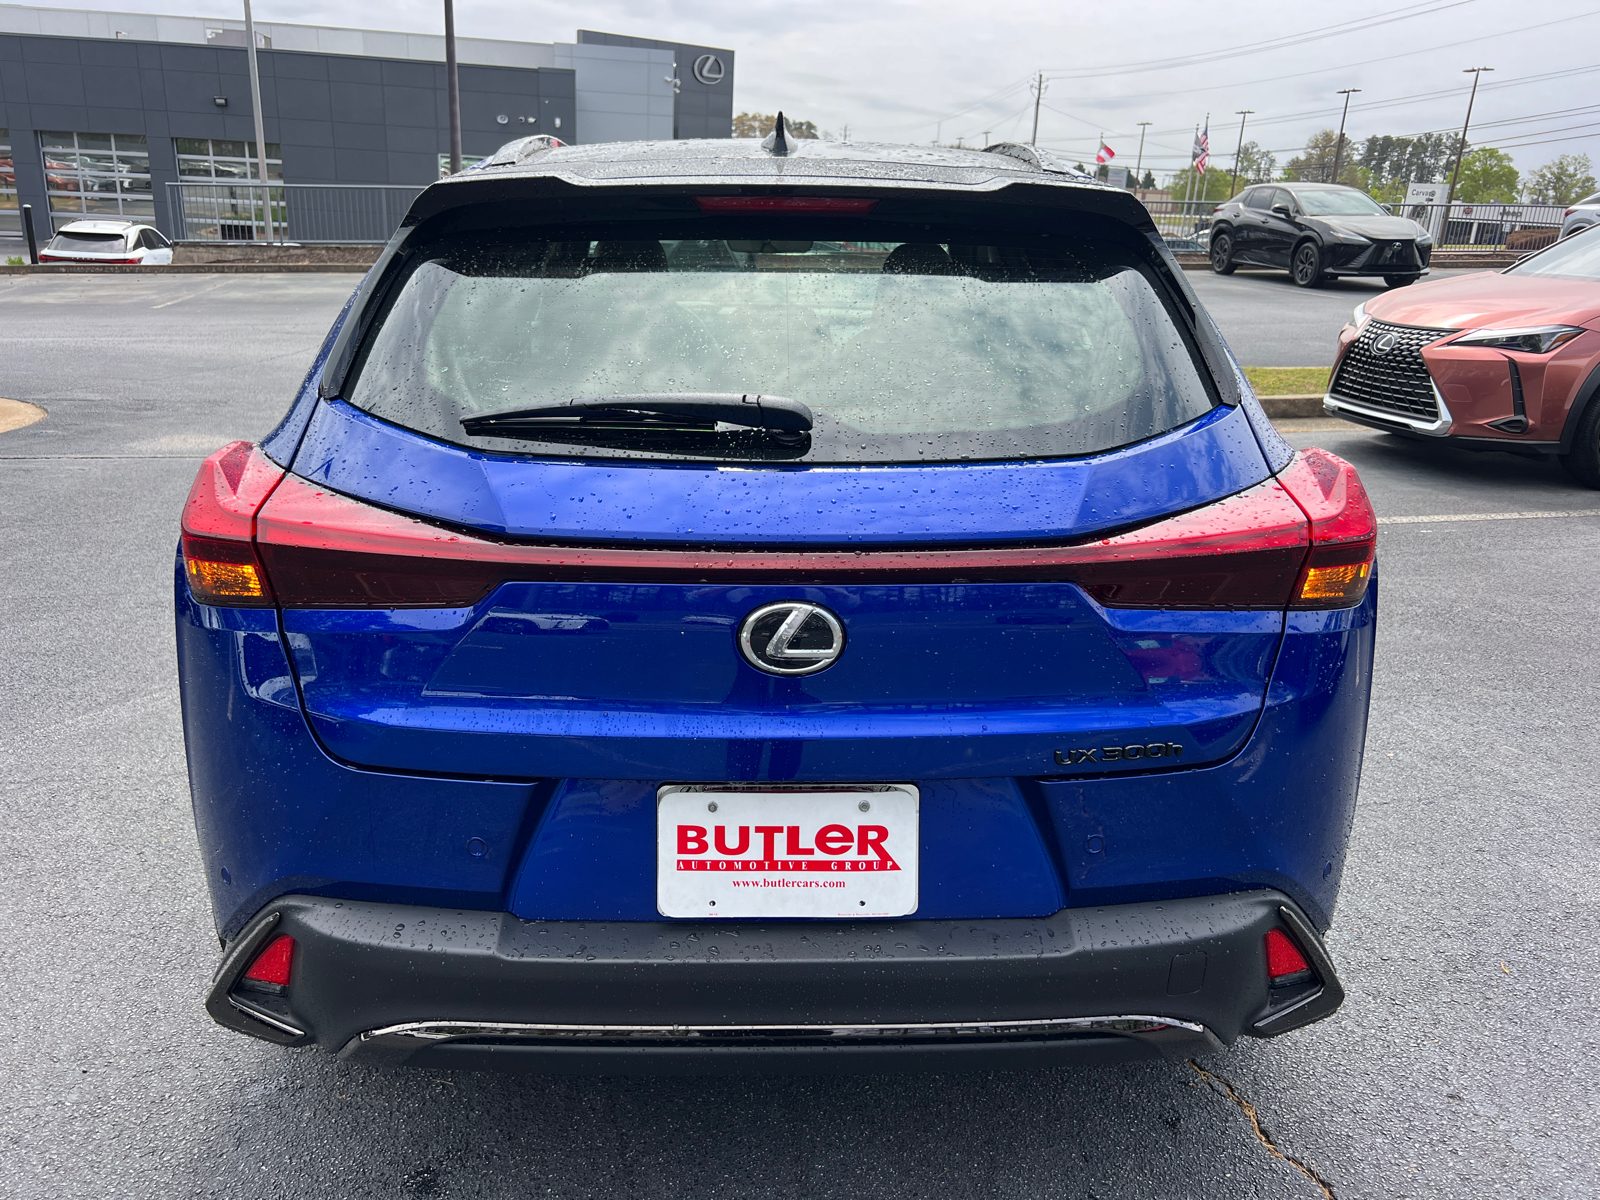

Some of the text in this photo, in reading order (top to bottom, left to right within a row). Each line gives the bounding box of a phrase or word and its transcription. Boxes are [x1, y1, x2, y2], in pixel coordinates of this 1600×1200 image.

[1054, 741, 1183, 765] UX 300h
[677, 860, 894, 871] AUTOMOTIVE GROUP
[732, 878, 846, 888] www.butlercars.com
